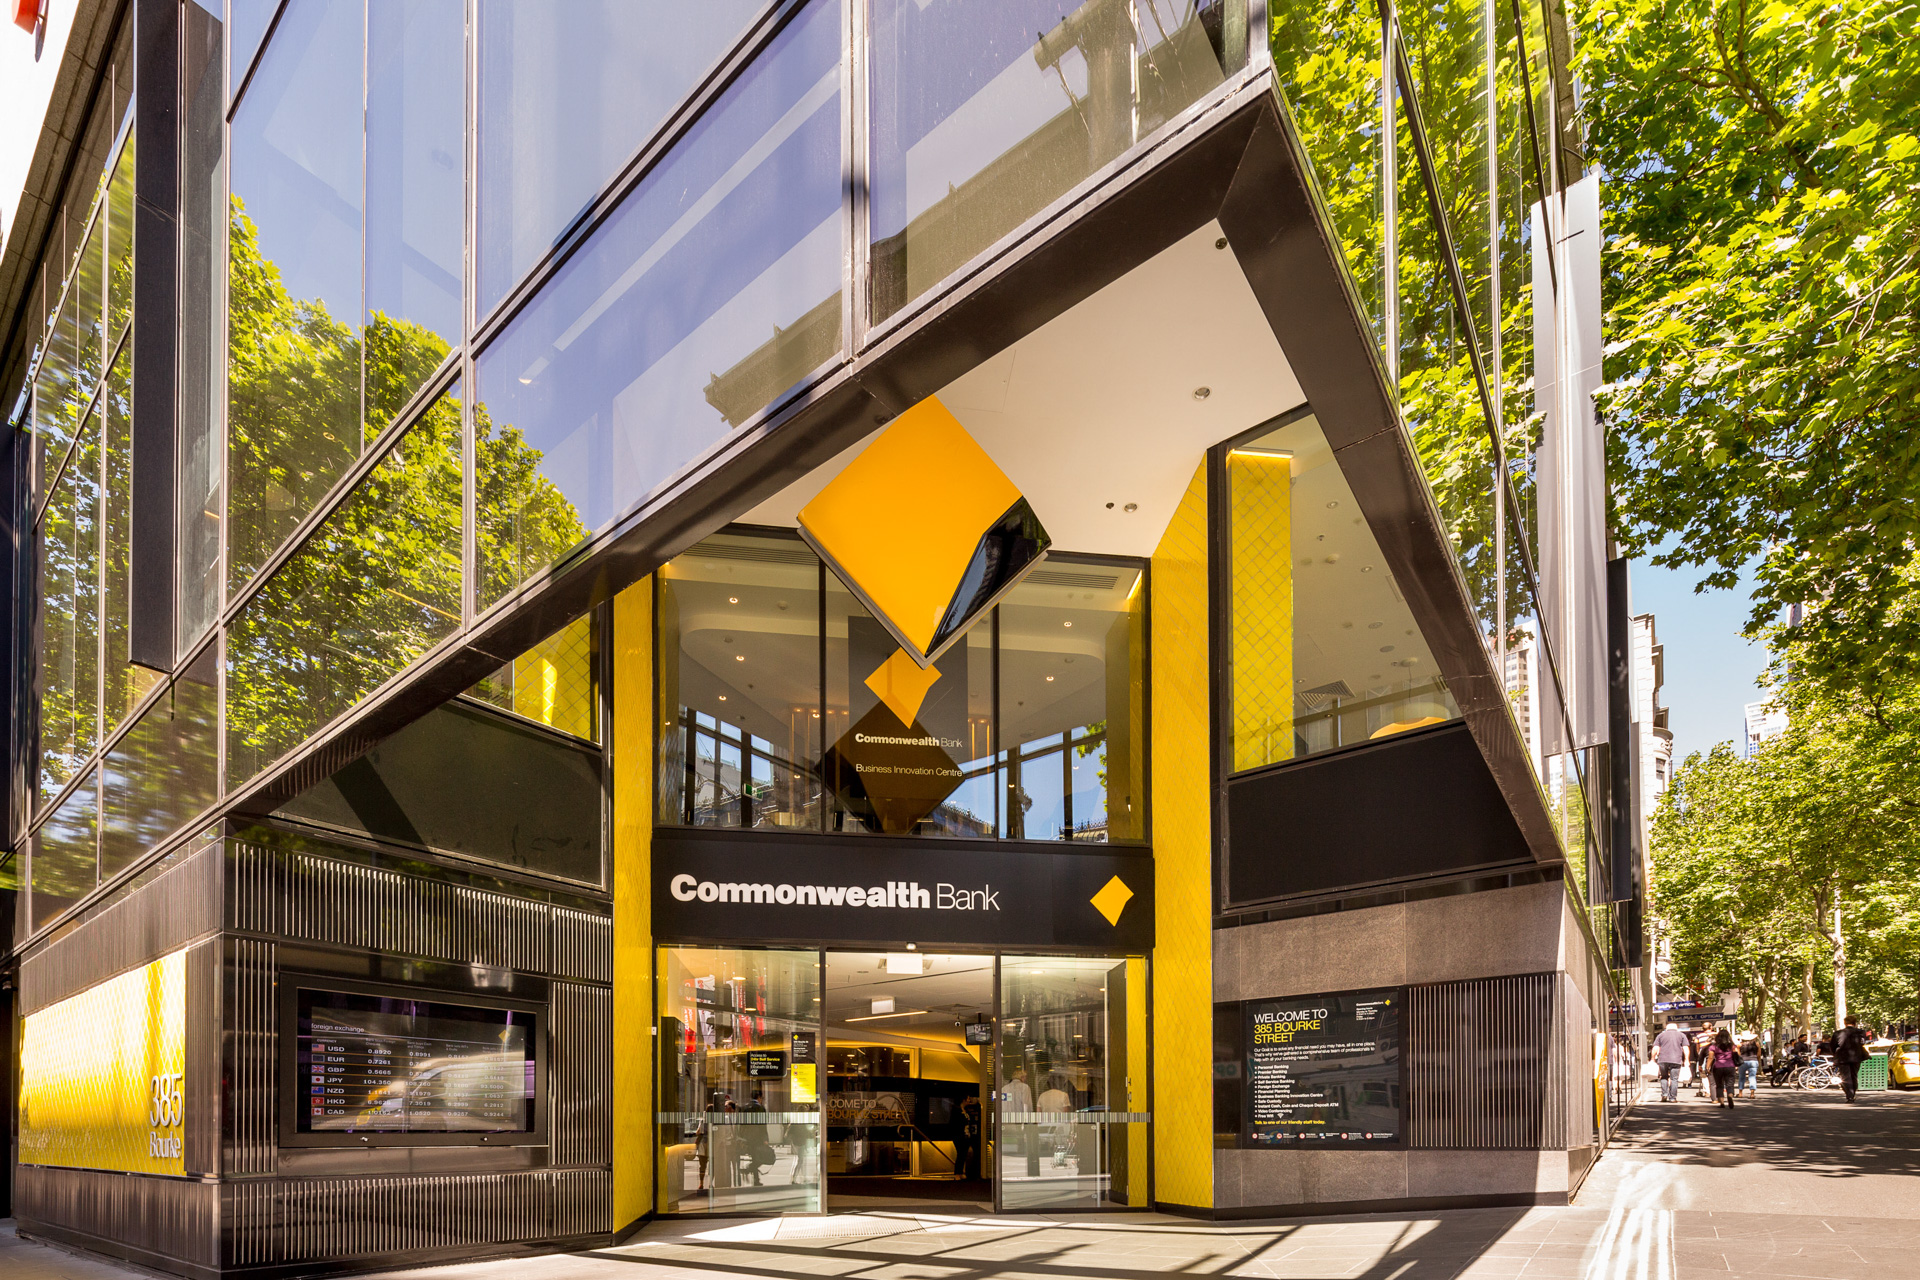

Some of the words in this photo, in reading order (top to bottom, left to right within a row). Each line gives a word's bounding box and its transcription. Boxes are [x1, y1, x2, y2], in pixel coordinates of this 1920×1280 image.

[855, 733, 940, 746] Commonwealth
[941, 738, 963, 748] Bank
[856, 764, 892, 773] Business
[894, 766, 934, 775] Innovation
[936, 768, 962, 776] Centre
[670, 873, 931, 909] Commonwealth
[936, 883, 1001, 912] Bank
[1254, 1010, 1310, 1024] WELCOME
[1311, 1008, 1328, 1019] TO
[334, 1024, 364, 1032] exchange
[1254, 1023, 1272, 1034] 385
[1274, 1020, 1320, 1032] BOURKE
[1254, 1032, 1295, 1044] STREET
[150, 1073, 183, 1127] 385
[828, 1098, 860, 1108] COME
[864, 1099, 876, 1108] TO
[827, 1109, 870, 1119] BOURKE
[872, 1110, 906, 1119] STREET
[150, 1131, 182, 1158] Bourke
